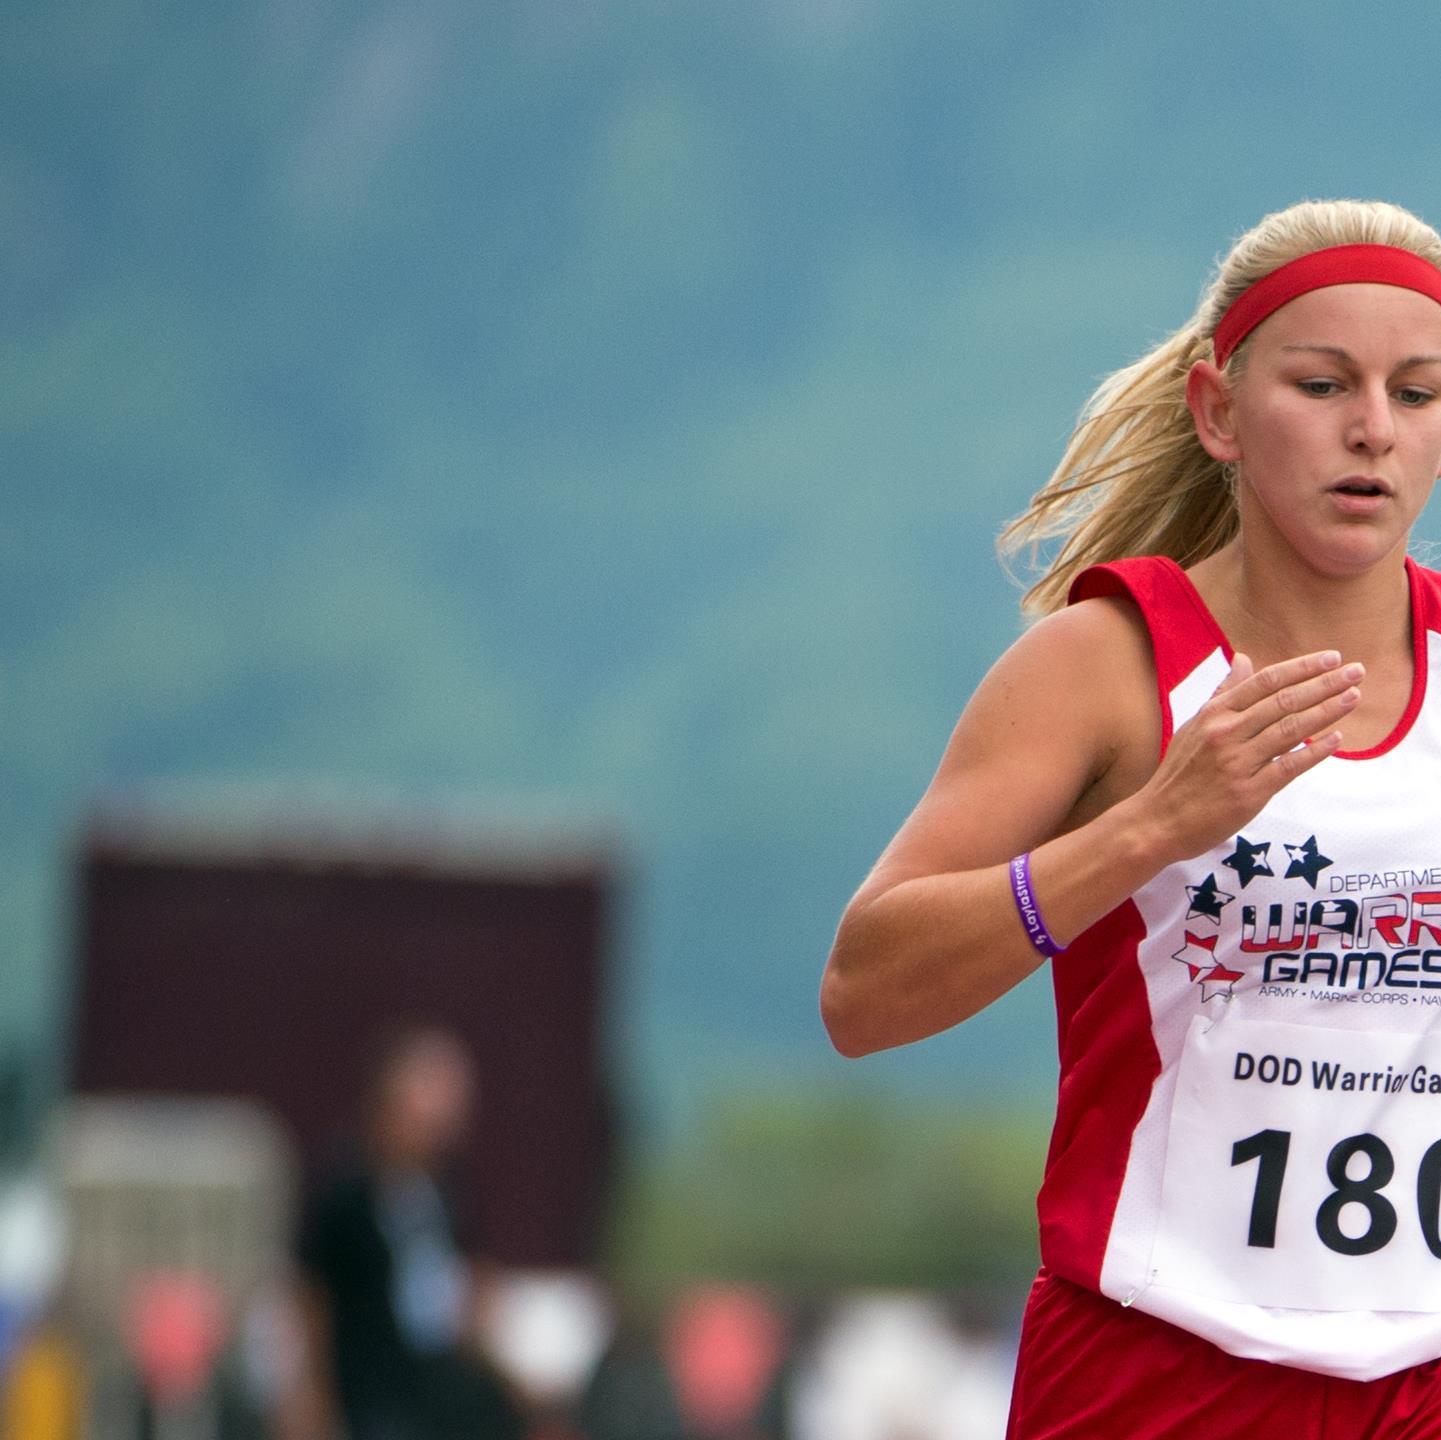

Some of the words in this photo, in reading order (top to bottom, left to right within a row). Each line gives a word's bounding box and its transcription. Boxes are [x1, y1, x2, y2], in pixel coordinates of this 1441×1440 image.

[1259, 985, 1298, 998] ARMY
[1361, 991, 1408, 1006] CORPS
[1233, 1052, 1303, 1086] DOD
[1311, 1060, 1409, 1094] Warrior
